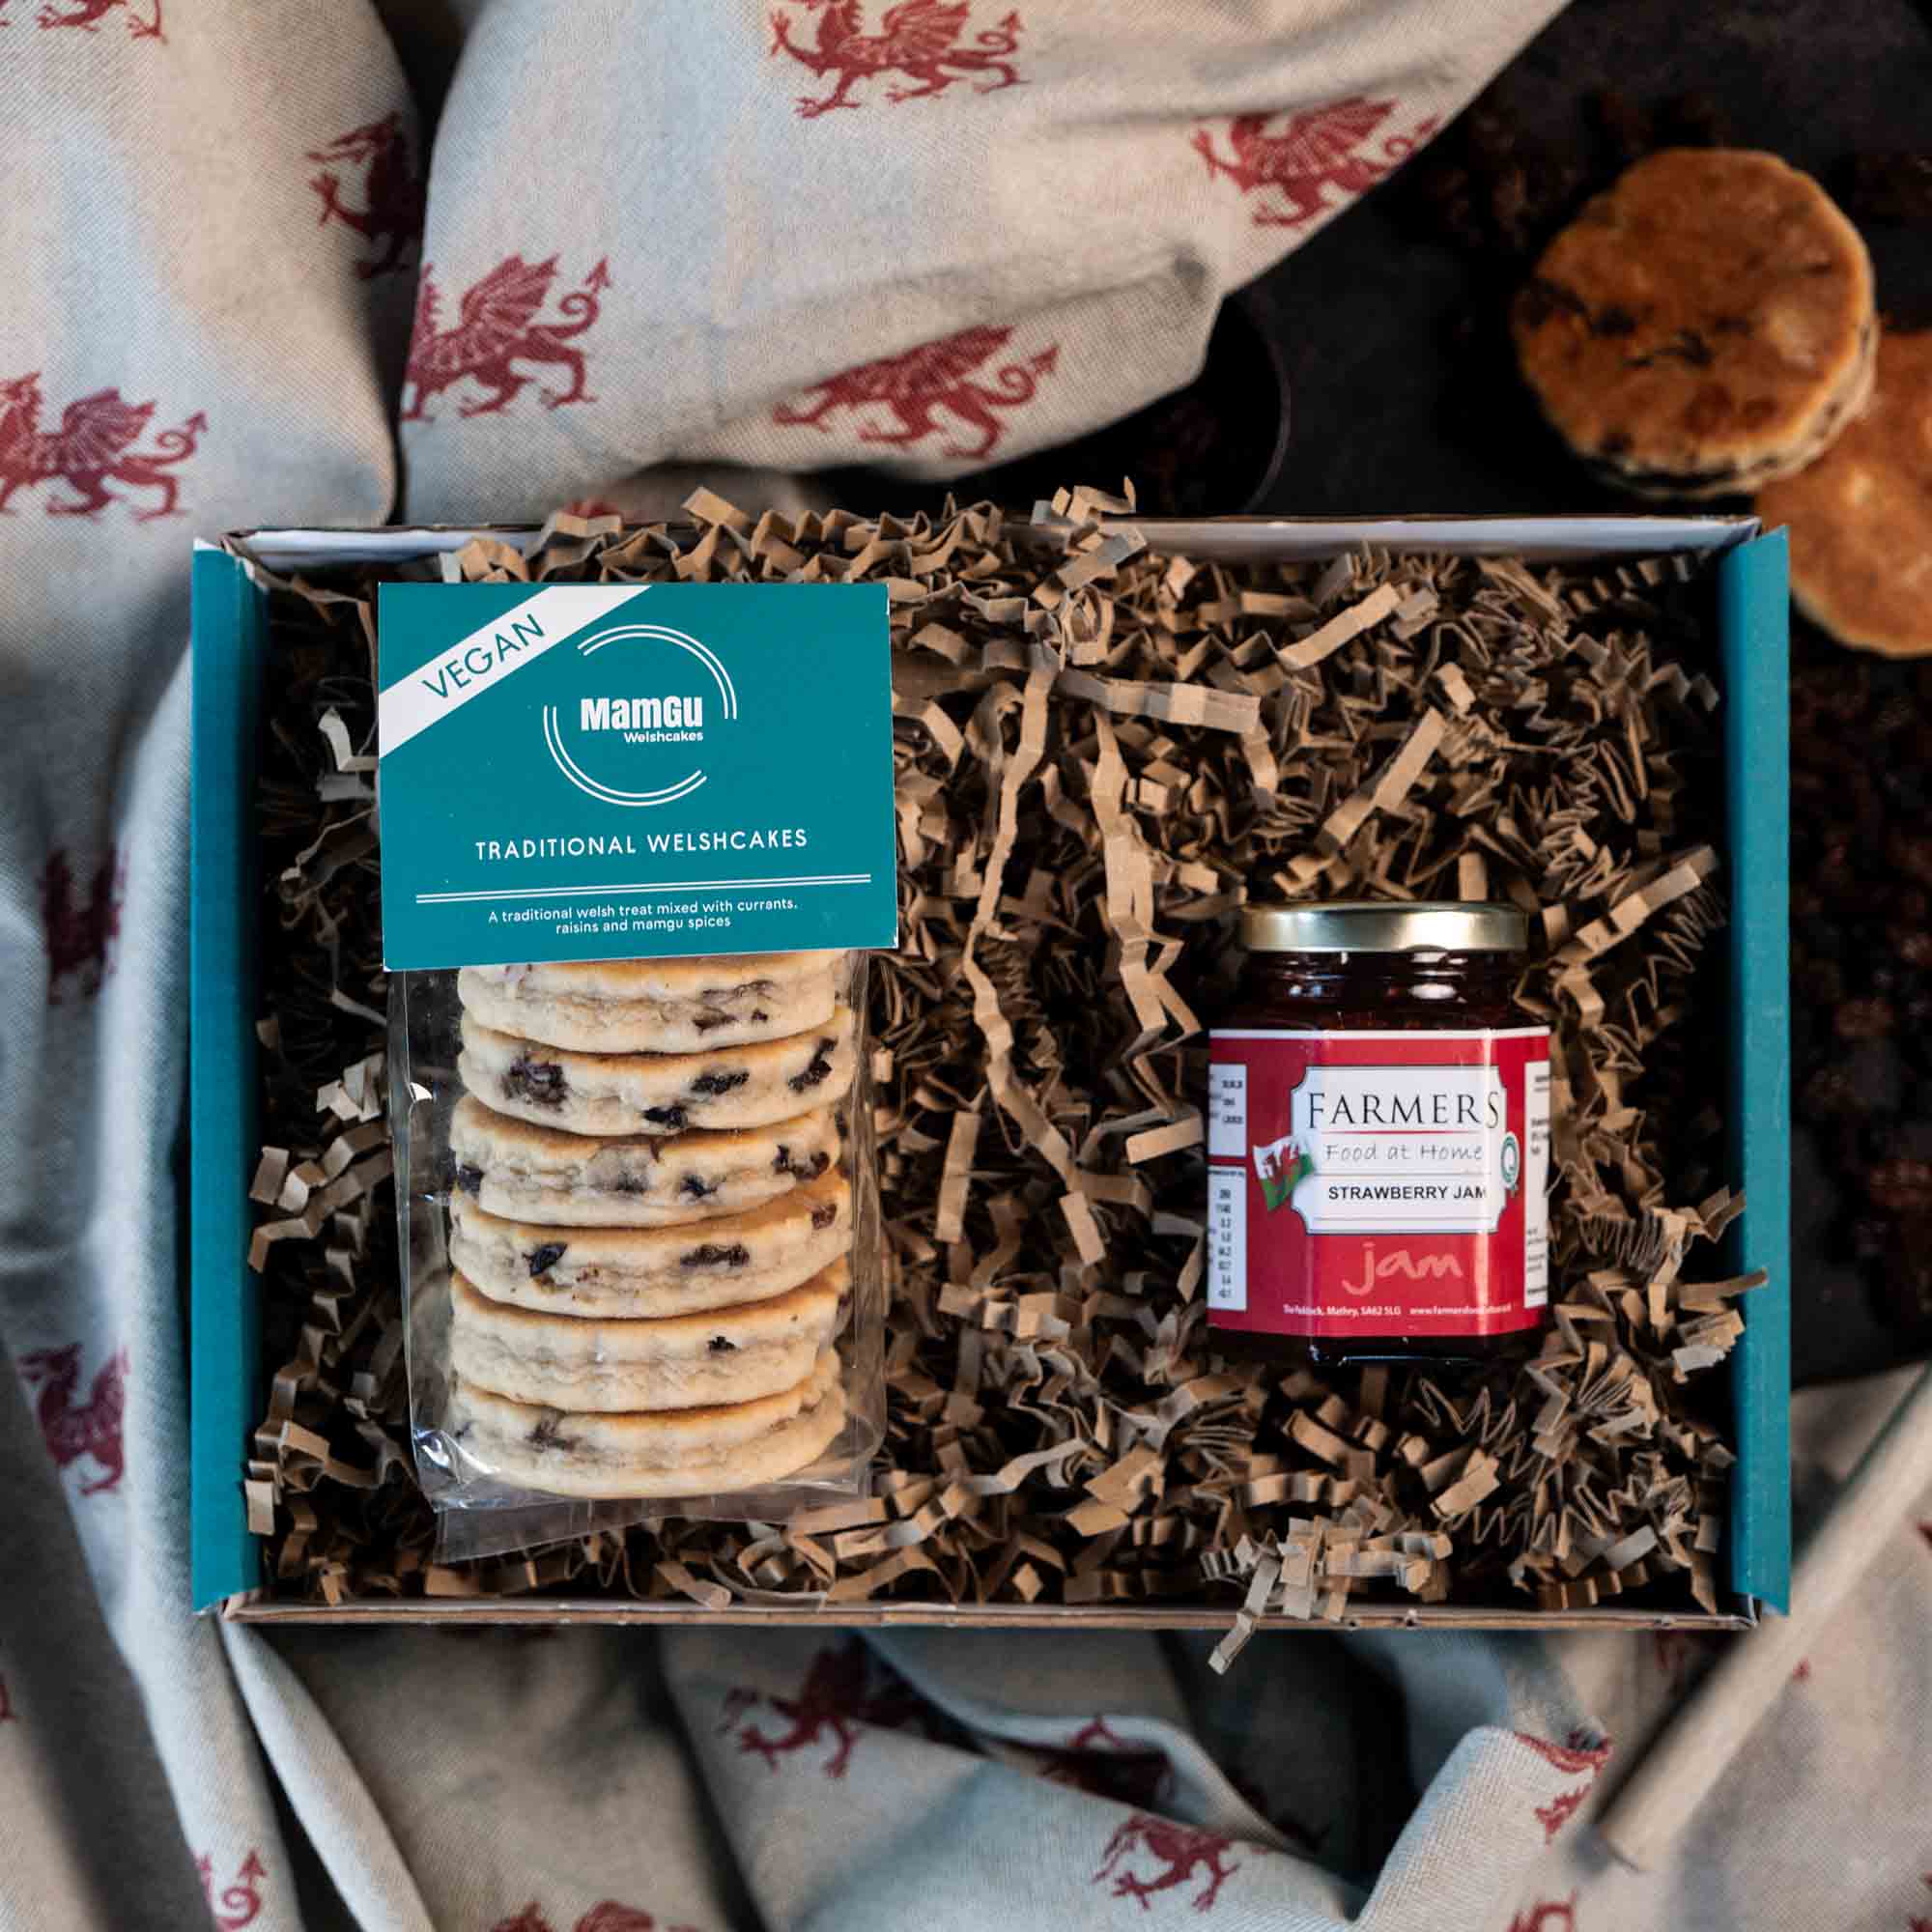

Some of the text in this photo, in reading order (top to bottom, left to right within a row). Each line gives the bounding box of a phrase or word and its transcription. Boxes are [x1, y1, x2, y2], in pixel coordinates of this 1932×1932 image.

[422, 612, 547, 700] VEGAN
[581, 696, 704, 732] MamGu
[623, 729, 704, 743] Welshcakes
[475, 828, 809, 861] TRADITIONAL WELSHCAKES
[488, 911, 497, 923] A
[502, 907, 572, 923] traditional
[577, 905, 614, 919] welsh
[618, 904, 652, 916] treat
[657, 901, 697, 915] mixed
[702, 900, 733, 912] with
[555, 916, 731, 934] raisins and mamgu spices
[1308, 1090, 1500, 1129] FARMERS
[1325, 1144, 1483, 1161] Food at Home
[1328, 1186, 1448, 1200] STRAWBERRY
[1341, 1241, 1463, 1296] jam
